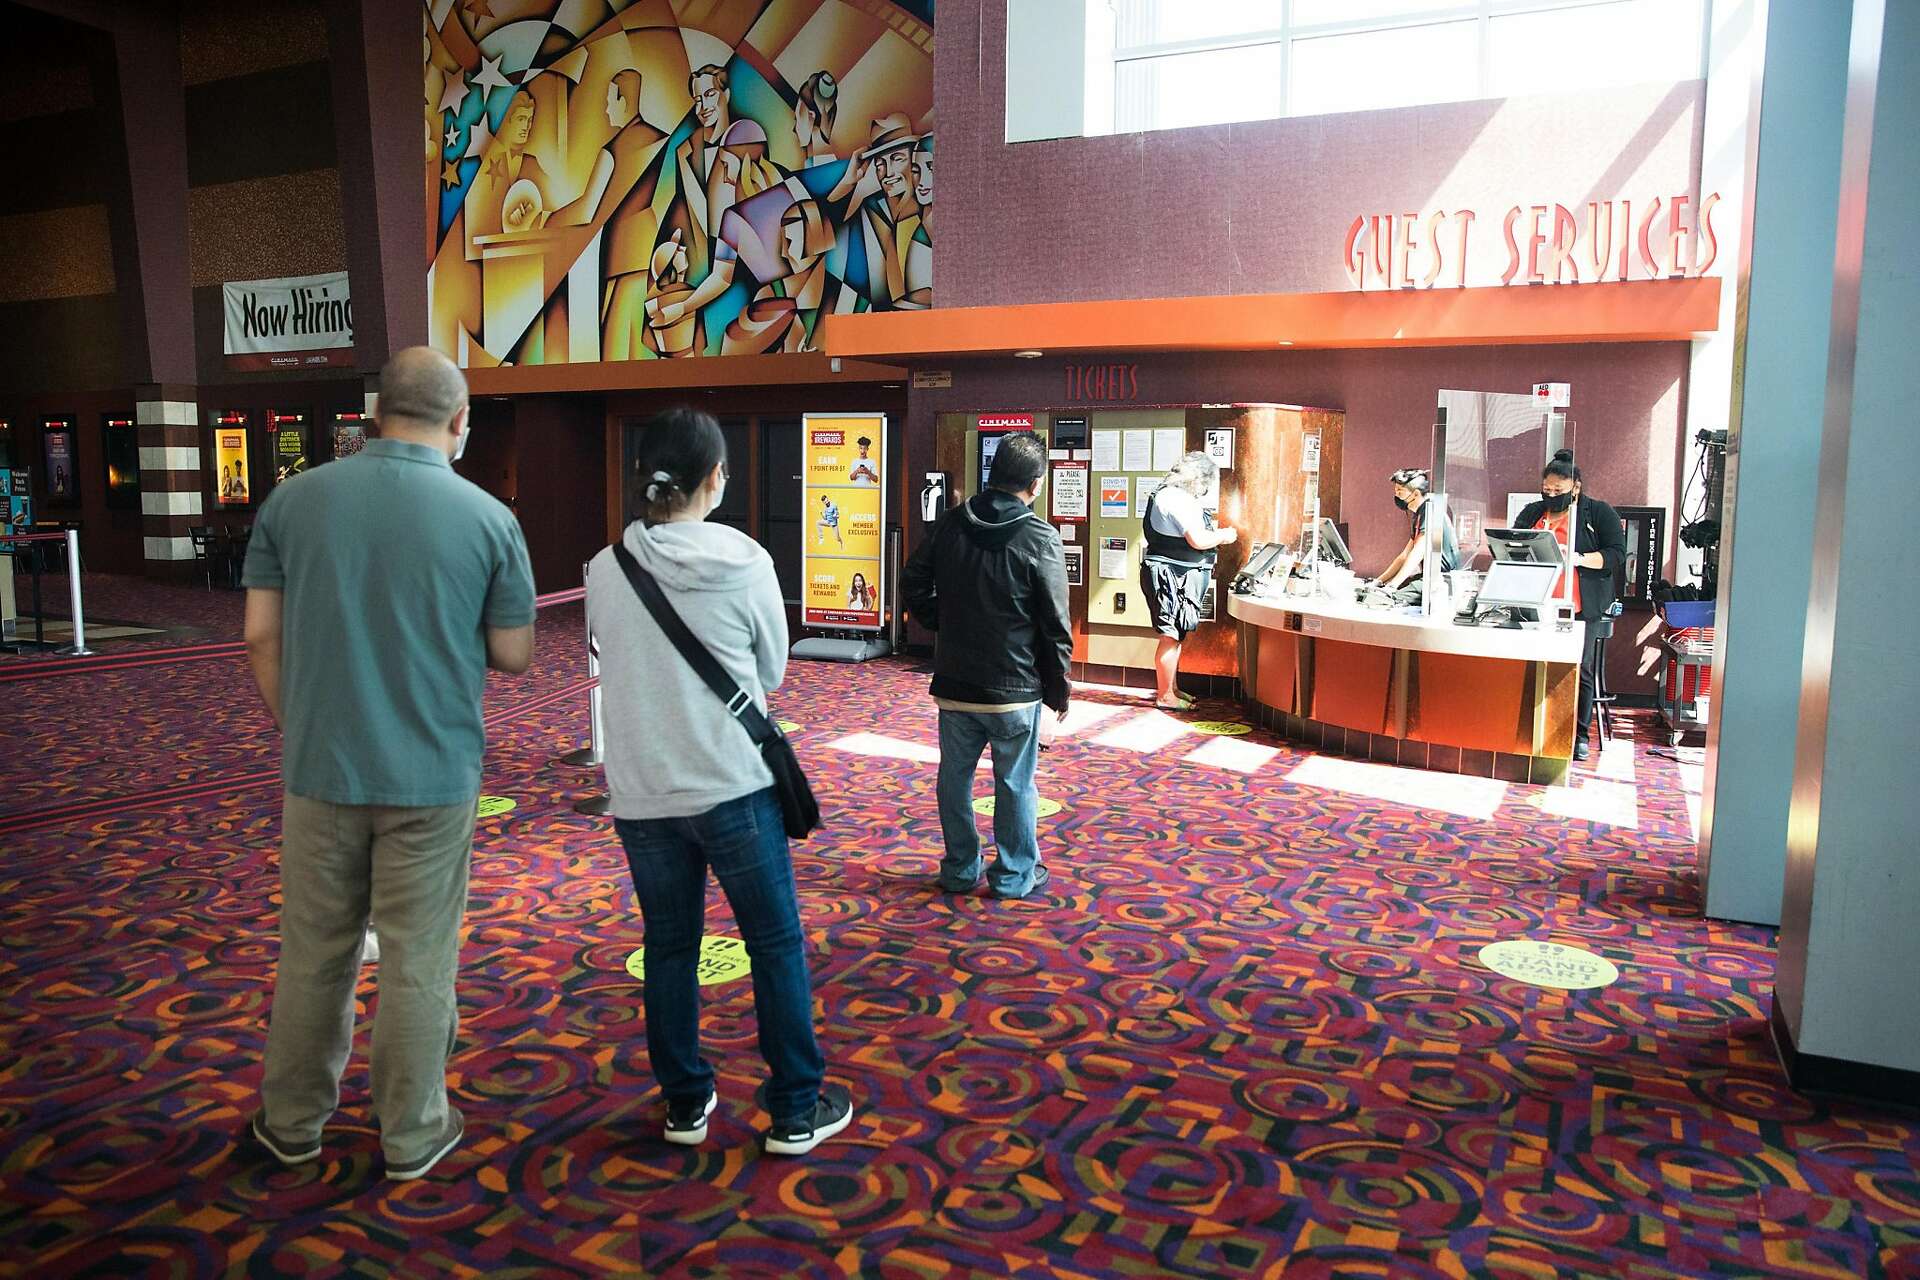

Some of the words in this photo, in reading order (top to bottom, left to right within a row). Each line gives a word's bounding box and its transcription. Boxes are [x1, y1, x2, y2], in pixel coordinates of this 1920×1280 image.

[1344, 209, 1475, 290] GUEST
[1500, 192, 1720, 286] SERVICES
[242, 292, 289, 338] Now
[1064, 364, 1138, 400] TICKETS
[978, 419, 1032, 427] CINEMARK
[1498, 953, 1598, 973] STAND
